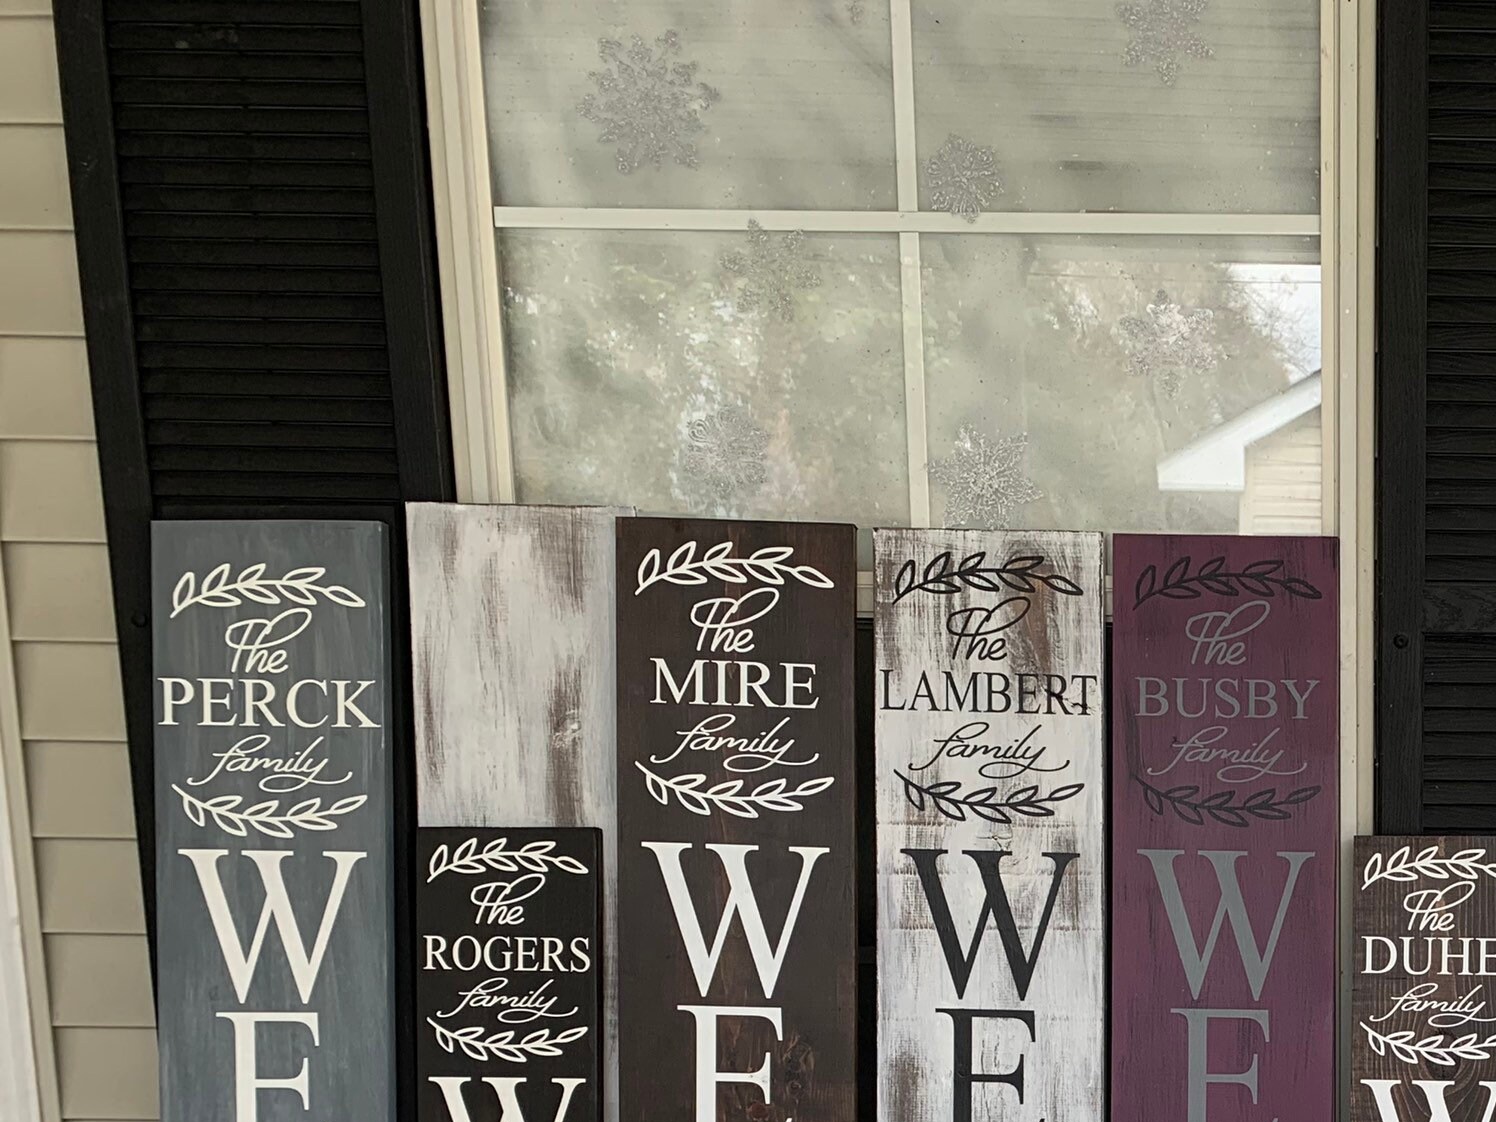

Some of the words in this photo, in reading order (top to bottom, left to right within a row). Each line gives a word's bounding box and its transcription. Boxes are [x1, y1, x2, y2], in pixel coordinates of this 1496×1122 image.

[225, 608, 312, 675] The
[691, 587, 780, 653] The
[946, 596, 1031, 662] The
[1184, 600, 1270, 666] The
[157, 677, 382, 730] PERCK
[649, 657, 820, 710] MIRE
[879, 669, 1098, 716] LAMBERT
[1134, 676, 1321, 720] BUSBY
[187, 734, 353, 793] family
[650, 713, 819, 772] family
[908, 721, 1070, 779] family
[1147, 725, 1308, 783] family
[470, 872, 546, 926] The
[1403, 880, 1476, 933] The
[422, 935, 592, 973] ROGERS
[437, 976, 579, 1023] family
